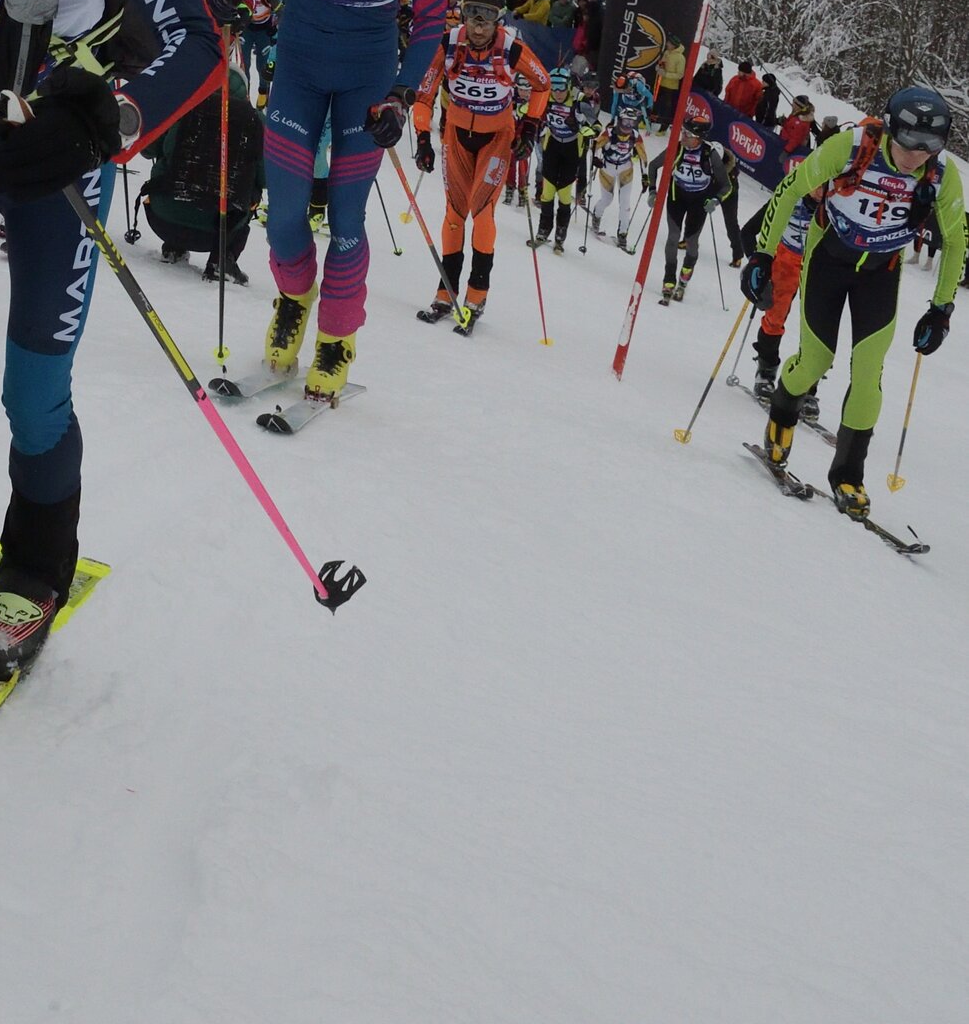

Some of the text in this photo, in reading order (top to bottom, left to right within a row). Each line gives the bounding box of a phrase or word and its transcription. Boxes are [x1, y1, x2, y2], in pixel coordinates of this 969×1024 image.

[454, 81, 498, 100] 265
[468, 104, 503, 112] DENZEL
[732, 124, 762, 157] Hervis
[858, 198, 911, 221] 129
[866, 227, 914, 243] DENZEL
